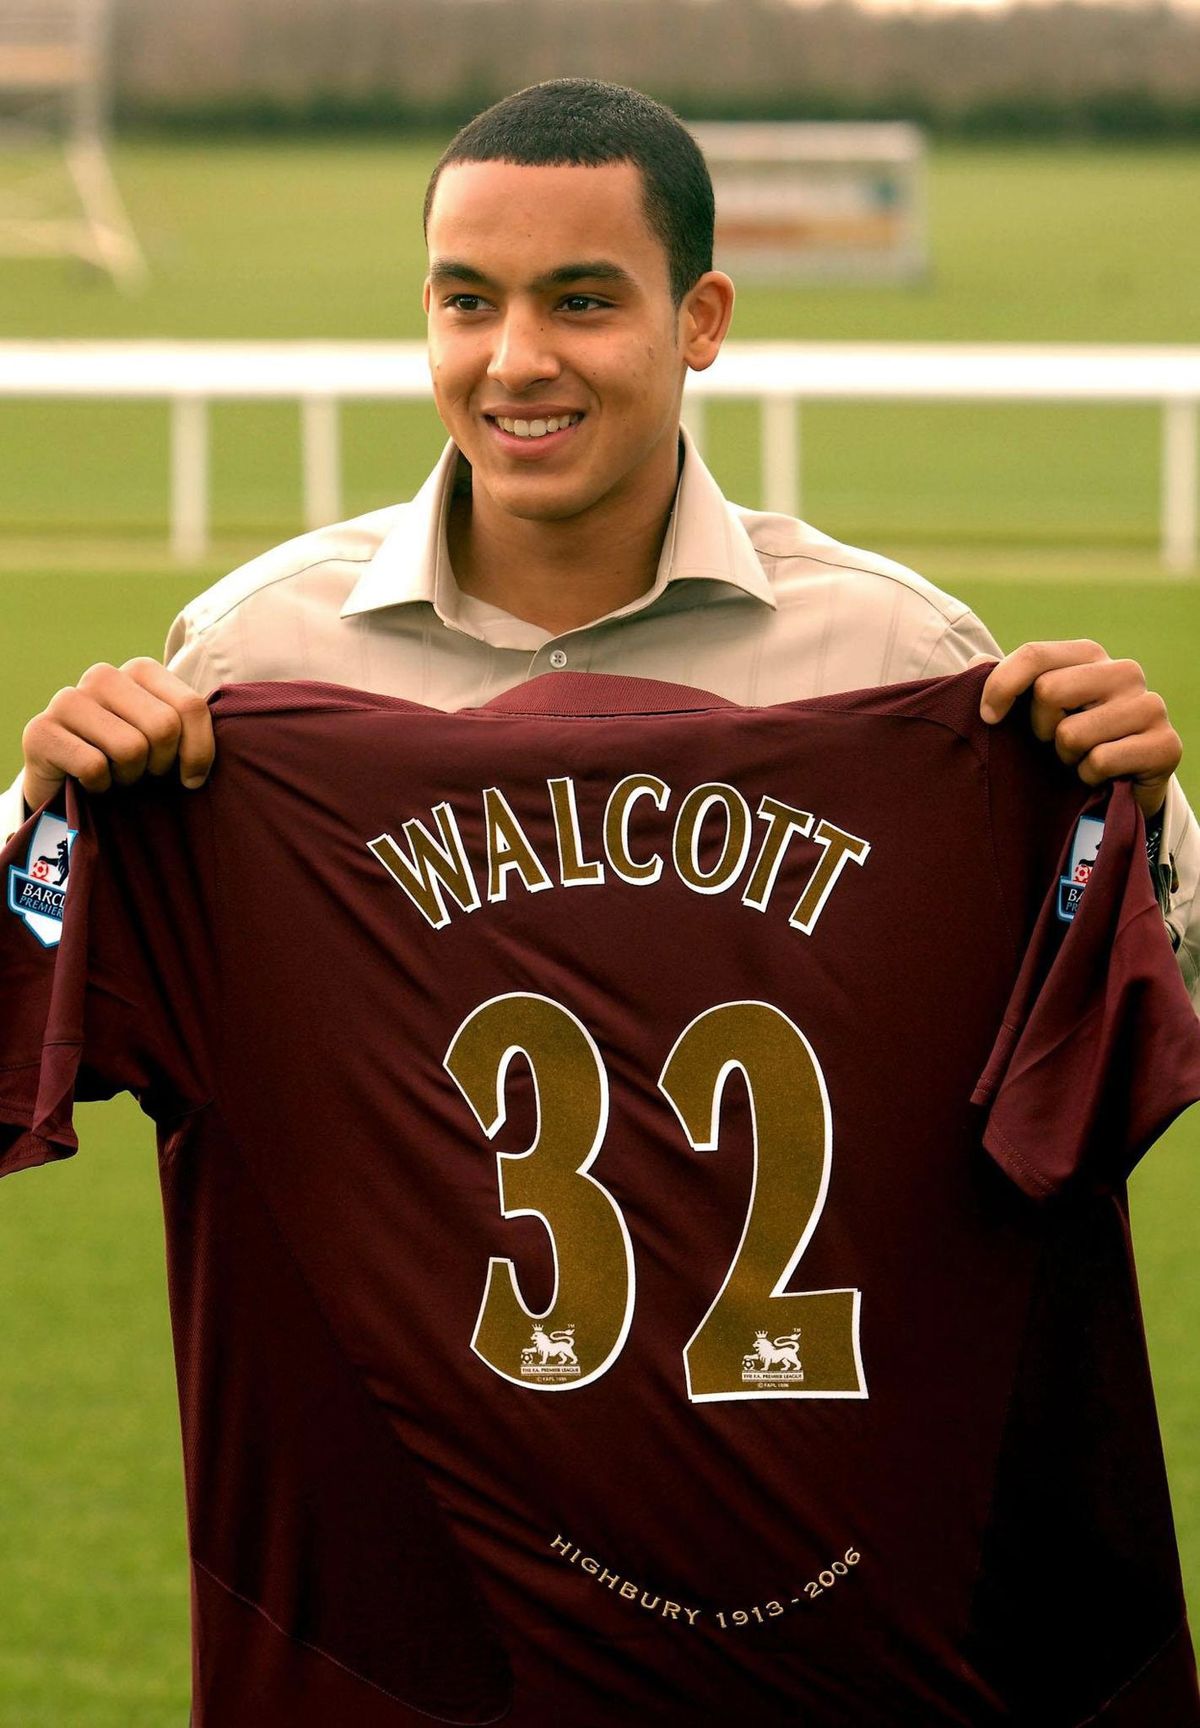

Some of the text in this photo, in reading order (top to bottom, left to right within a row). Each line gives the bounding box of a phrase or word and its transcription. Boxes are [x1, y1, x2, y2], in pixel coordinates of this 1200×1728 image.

[366, 774, 871, 936] WALCOTT
[443, 992, 869, 1403] 32
[550, 1534, 701, 1625] HIGHBURY
[716, 1600, 784, 1628] 1913
[804, 1547, 861, 1599] 2006
